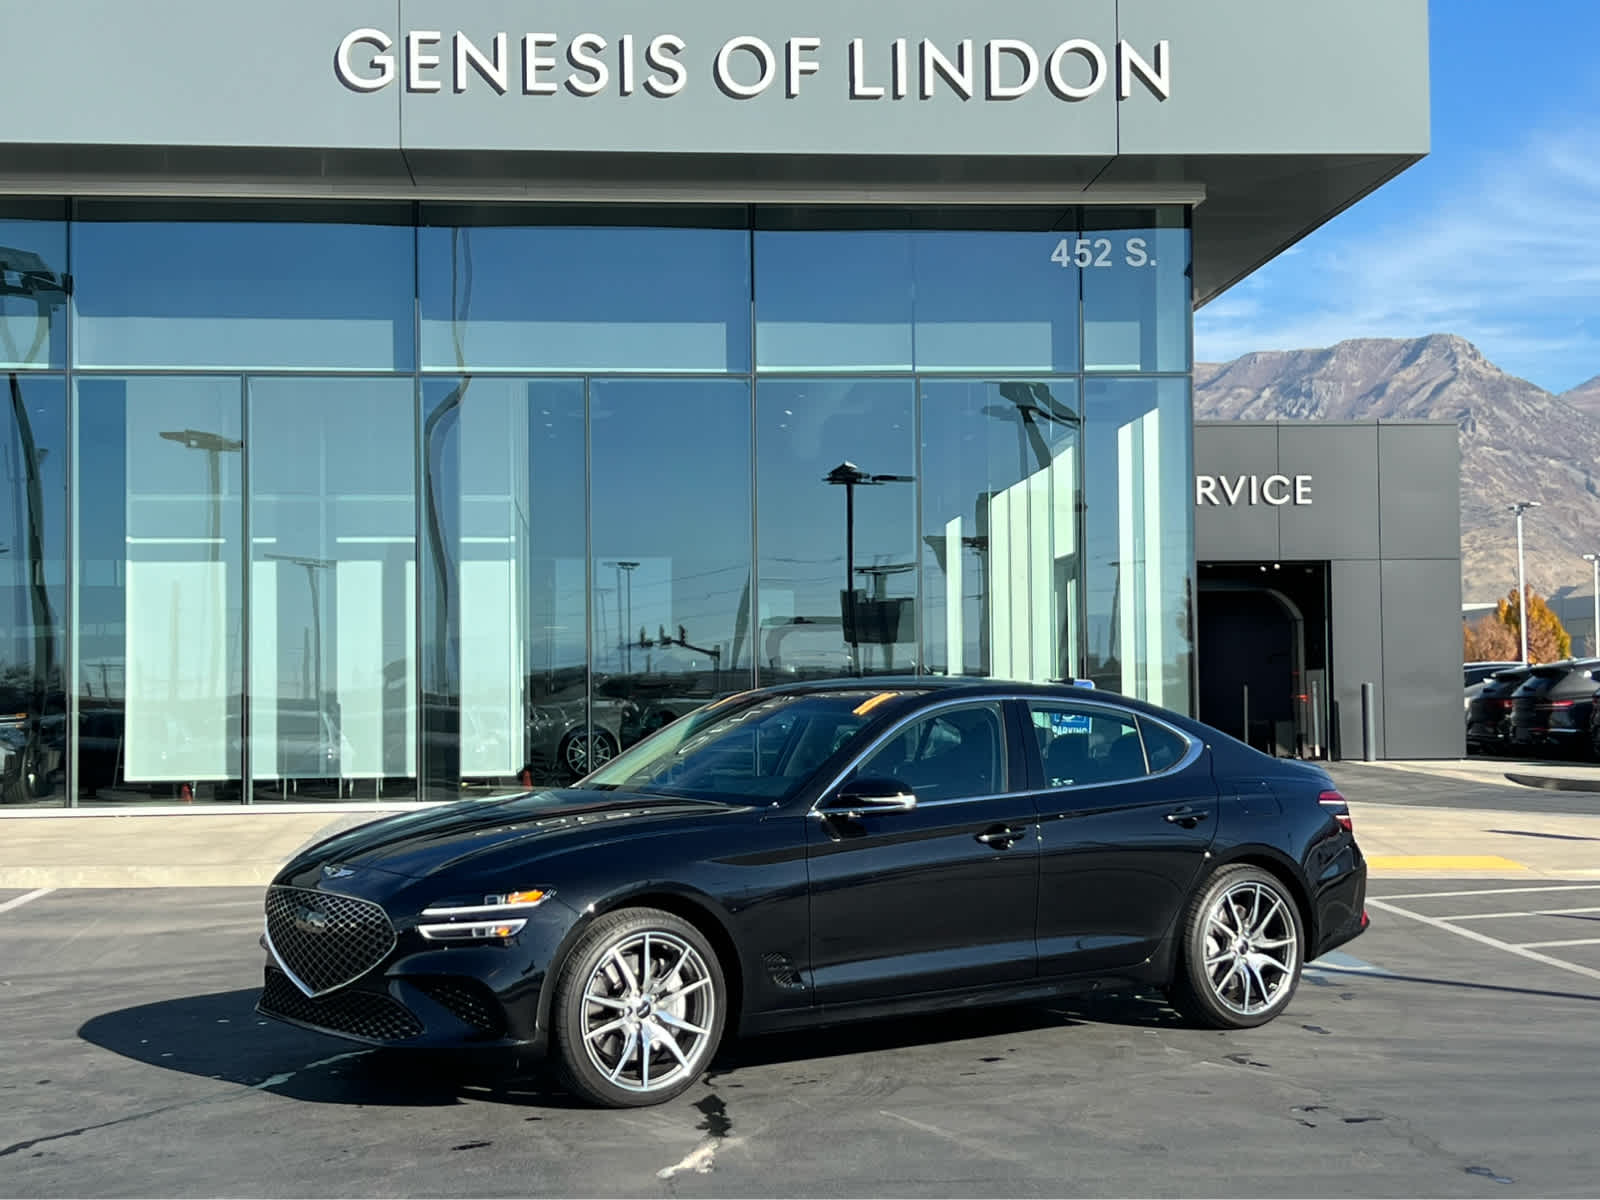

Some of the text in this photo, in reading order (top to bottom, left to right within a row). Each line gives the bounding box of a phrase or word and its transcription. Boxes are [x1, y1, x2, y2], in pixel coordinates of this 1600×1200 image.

[335, 28, 1169, 101] GENESIS OF LINDON
[1050, 238, 1157, 267] 452 S.
[1196, 474, 1313, 505] RVICE
